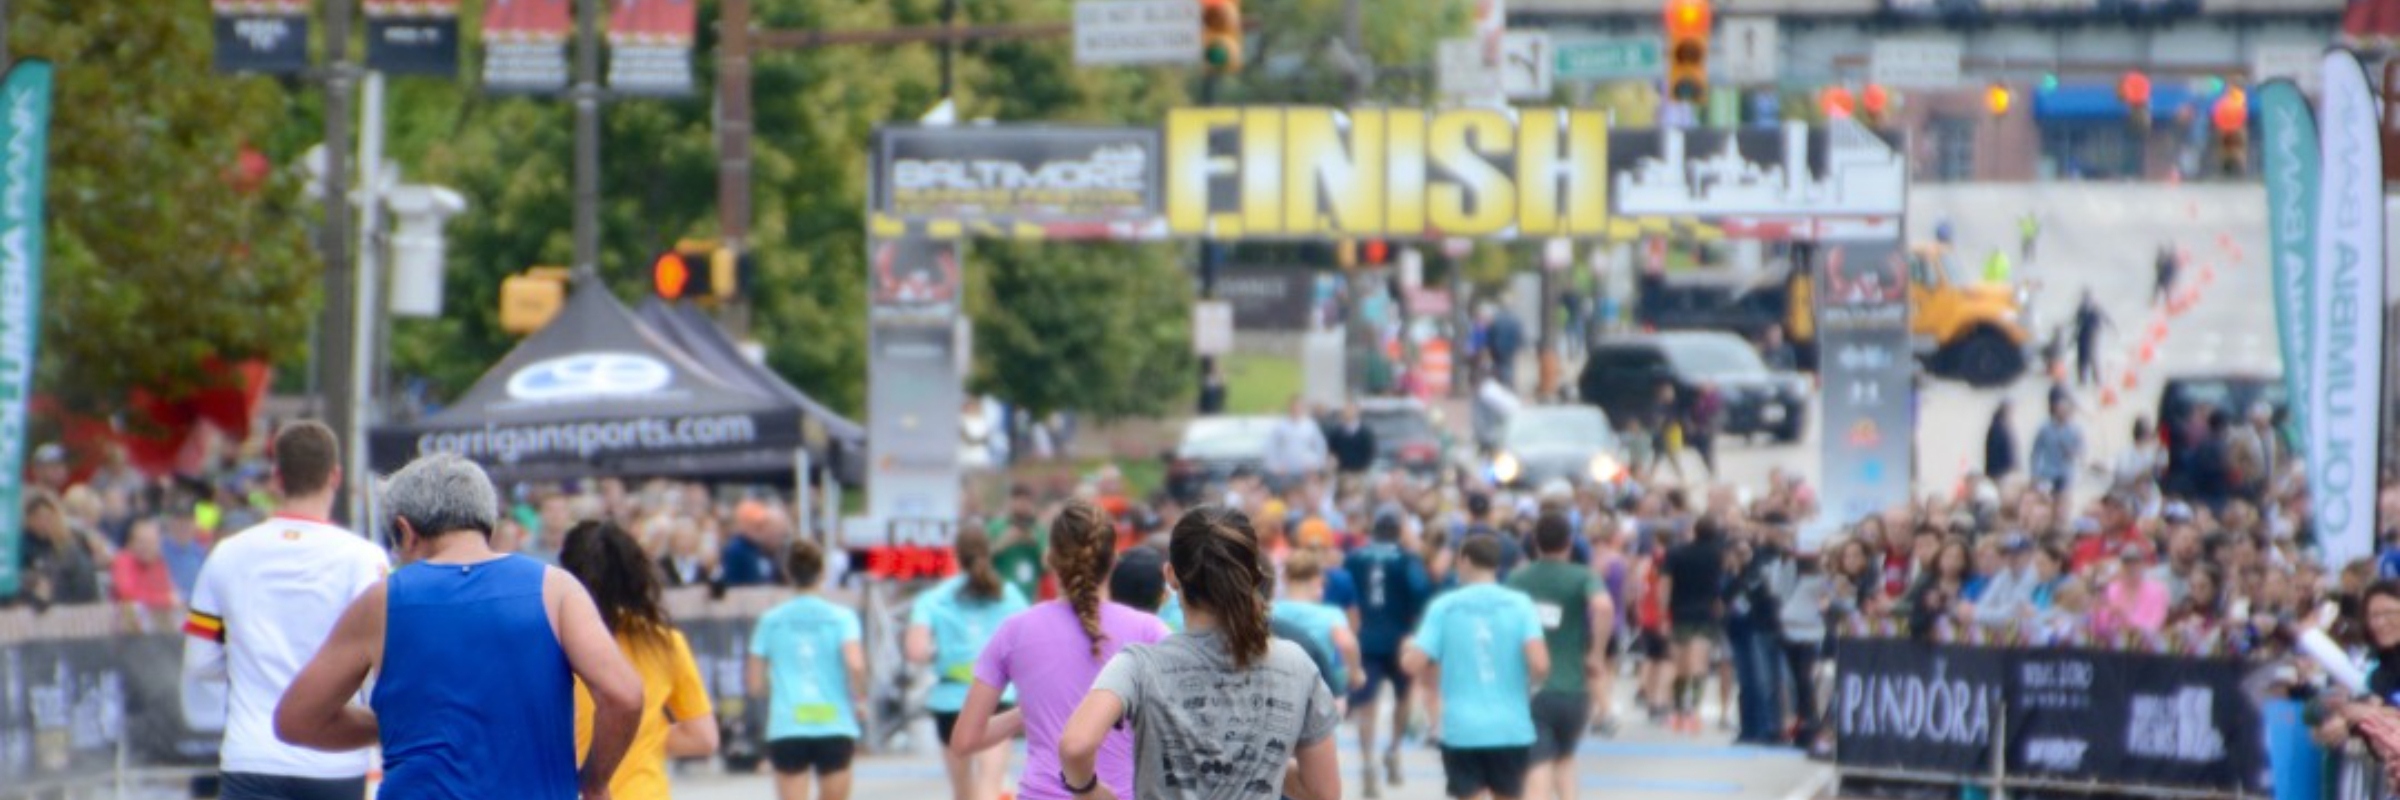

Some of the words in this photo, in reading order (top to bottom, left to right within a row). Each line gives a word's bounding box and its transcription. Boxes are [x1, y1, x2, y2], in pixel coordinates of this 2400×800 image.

[893, 158, 1146, 190] BALTIMORE
[1167, 107, 1607, 235] FINISH
[2322, 239, 2361, 536] COLUMBIA
[417, 412, 756, 463] corrigansports.com
